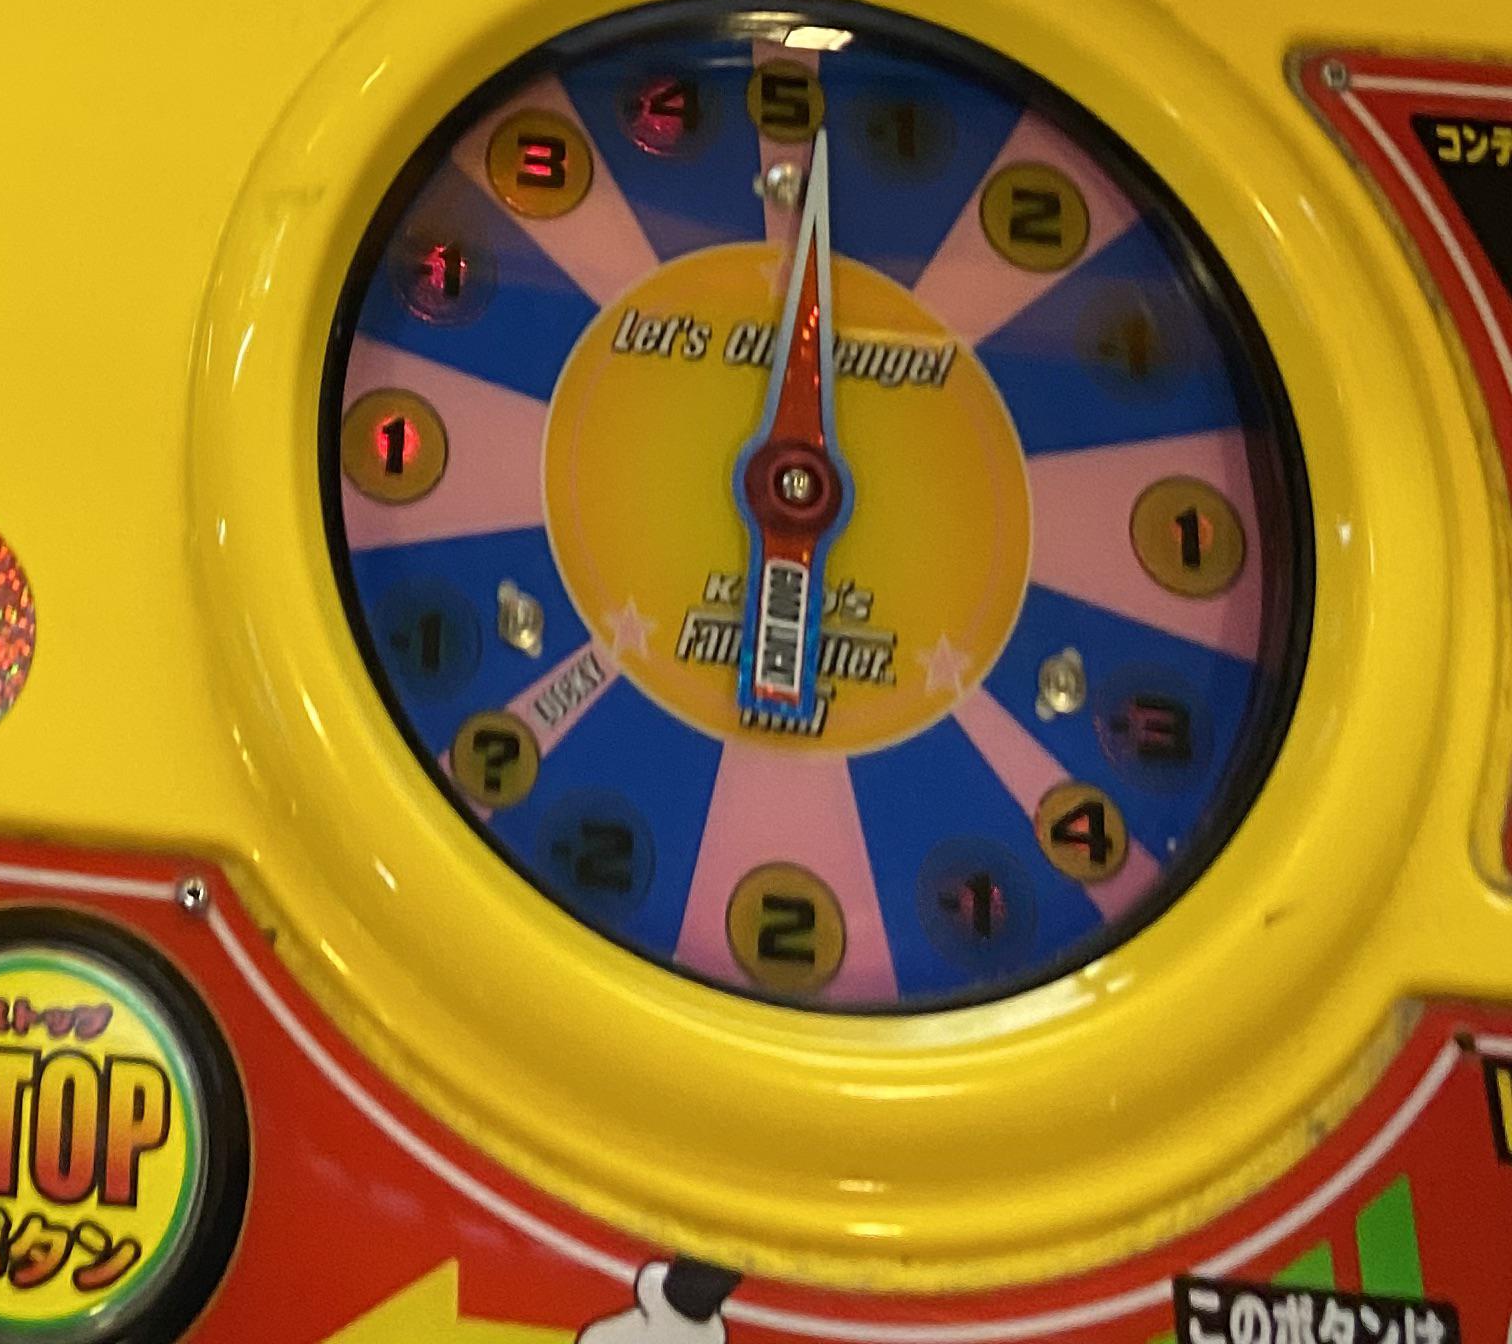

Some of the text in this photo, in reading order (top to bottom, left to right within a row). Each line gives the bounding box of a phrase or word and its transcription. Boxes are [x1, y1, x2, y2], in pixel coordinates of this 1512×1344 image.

[761, 73, 810, 127] 5
[516, 135, 567, 189] 3
[1009, 186, 1063, 247] 2
[613, 308, 712, 359] Let's
[382, 417, 406, 476] 1
[1174, 505, 1202, 569] 1
[473, 729, 521, 794] ?
[1050, 801, 1113, 867] 4
[756, 893, 816, 964] 2
